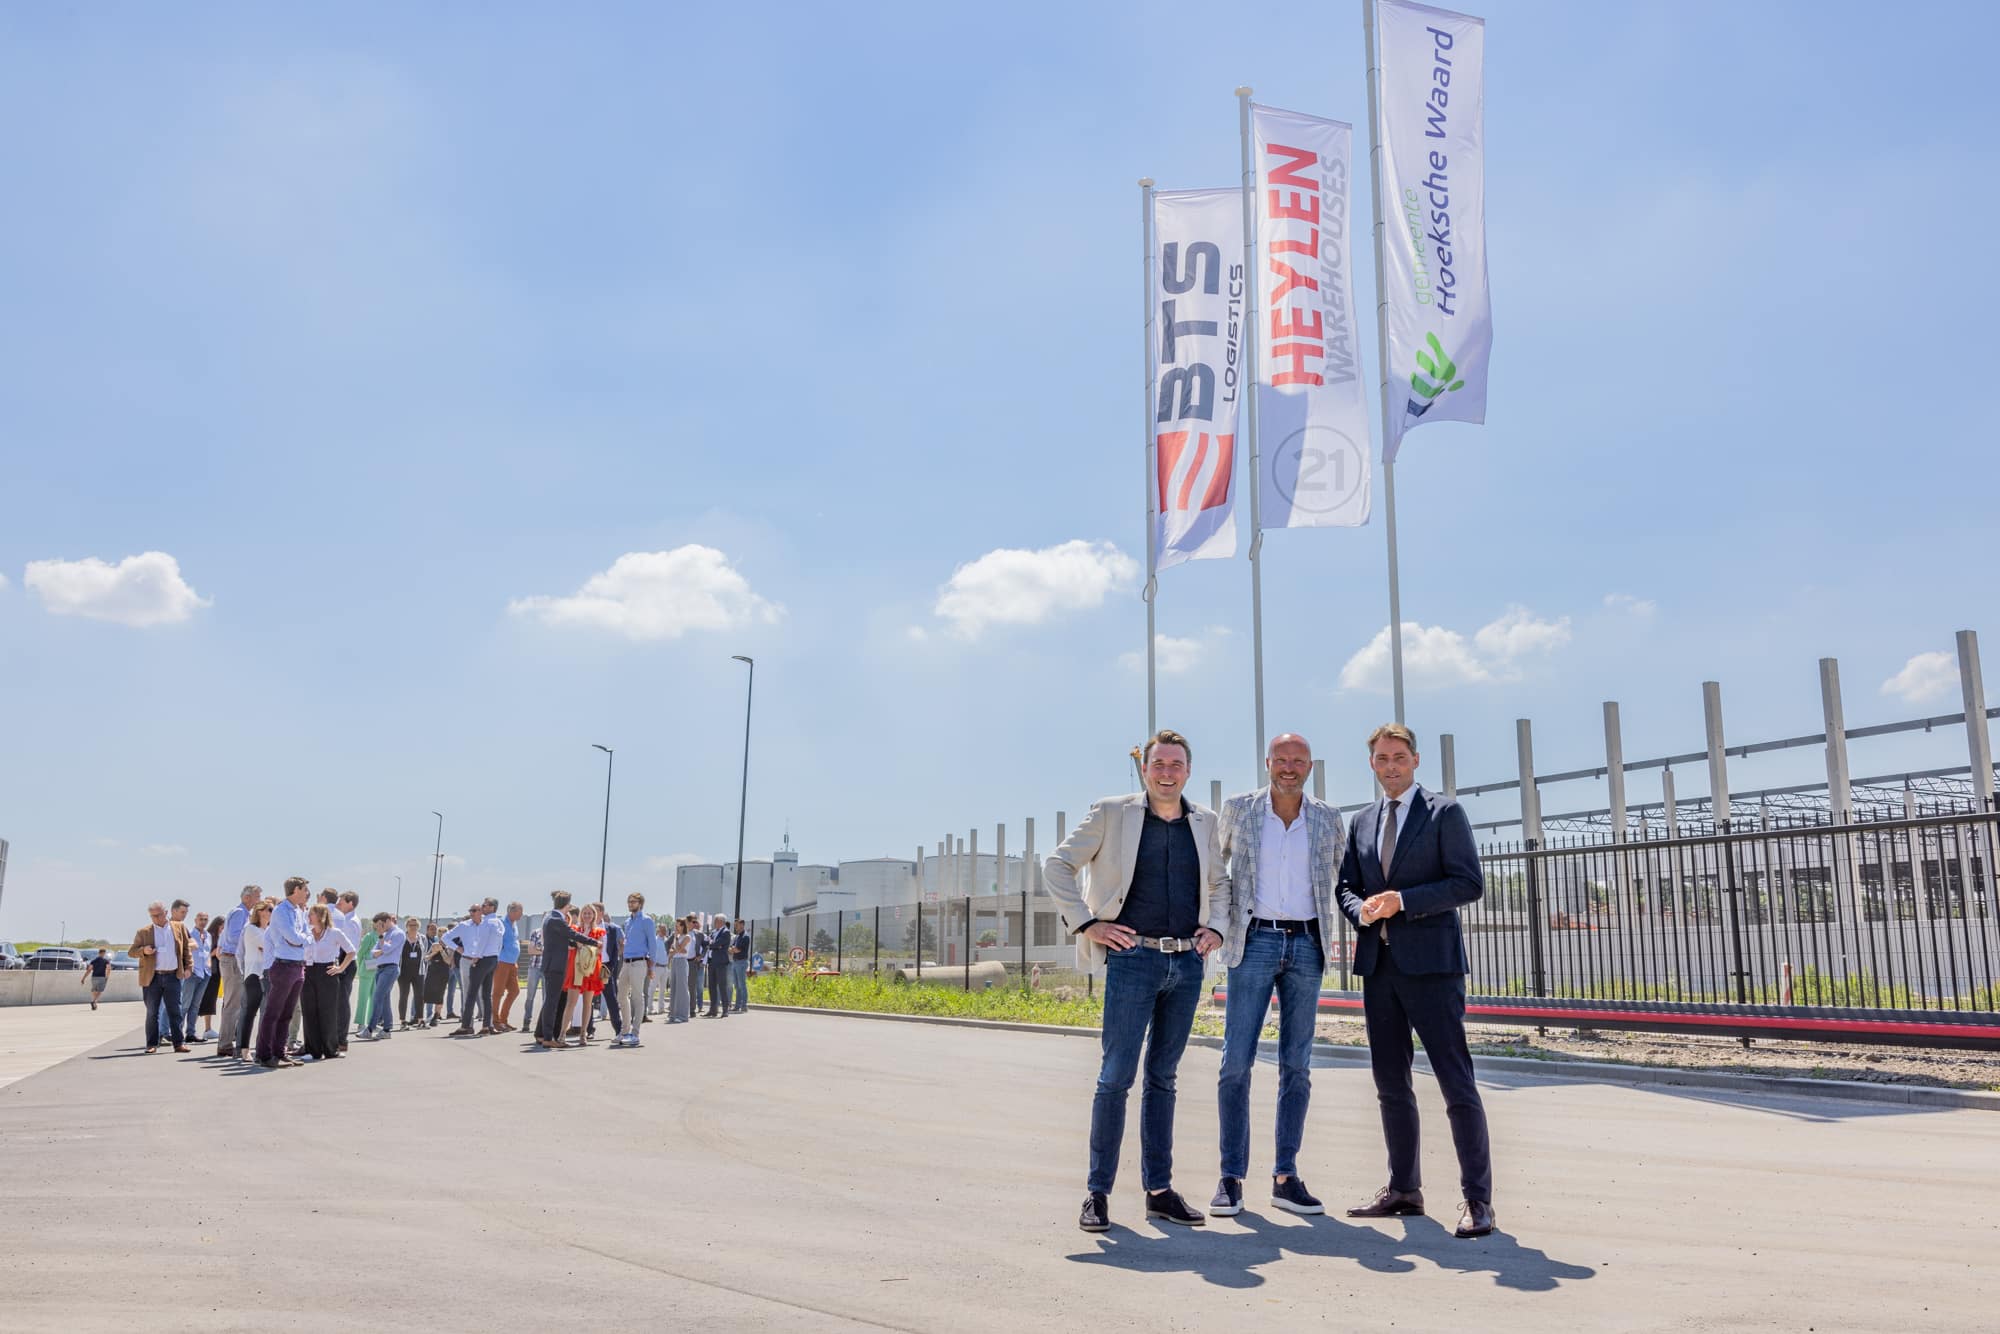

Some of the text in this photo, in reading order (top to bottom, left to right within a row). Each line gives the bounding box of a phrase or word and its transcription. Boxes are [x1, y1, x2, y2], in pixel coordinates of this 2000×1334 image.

[1405, 188, 1434, 305] gemeente
[1422, 26, 1456, 316] Hoeksche Waard
[1157, 241, 1221, 423] BTS
[1223, 263, 1243, 403] LOGISTICS
[1267, 143, 1324, 387] HEYLEN
[1320, 155, 1356, 385] WAREHOUSES
[1293, 448, 1345, 492] 21
